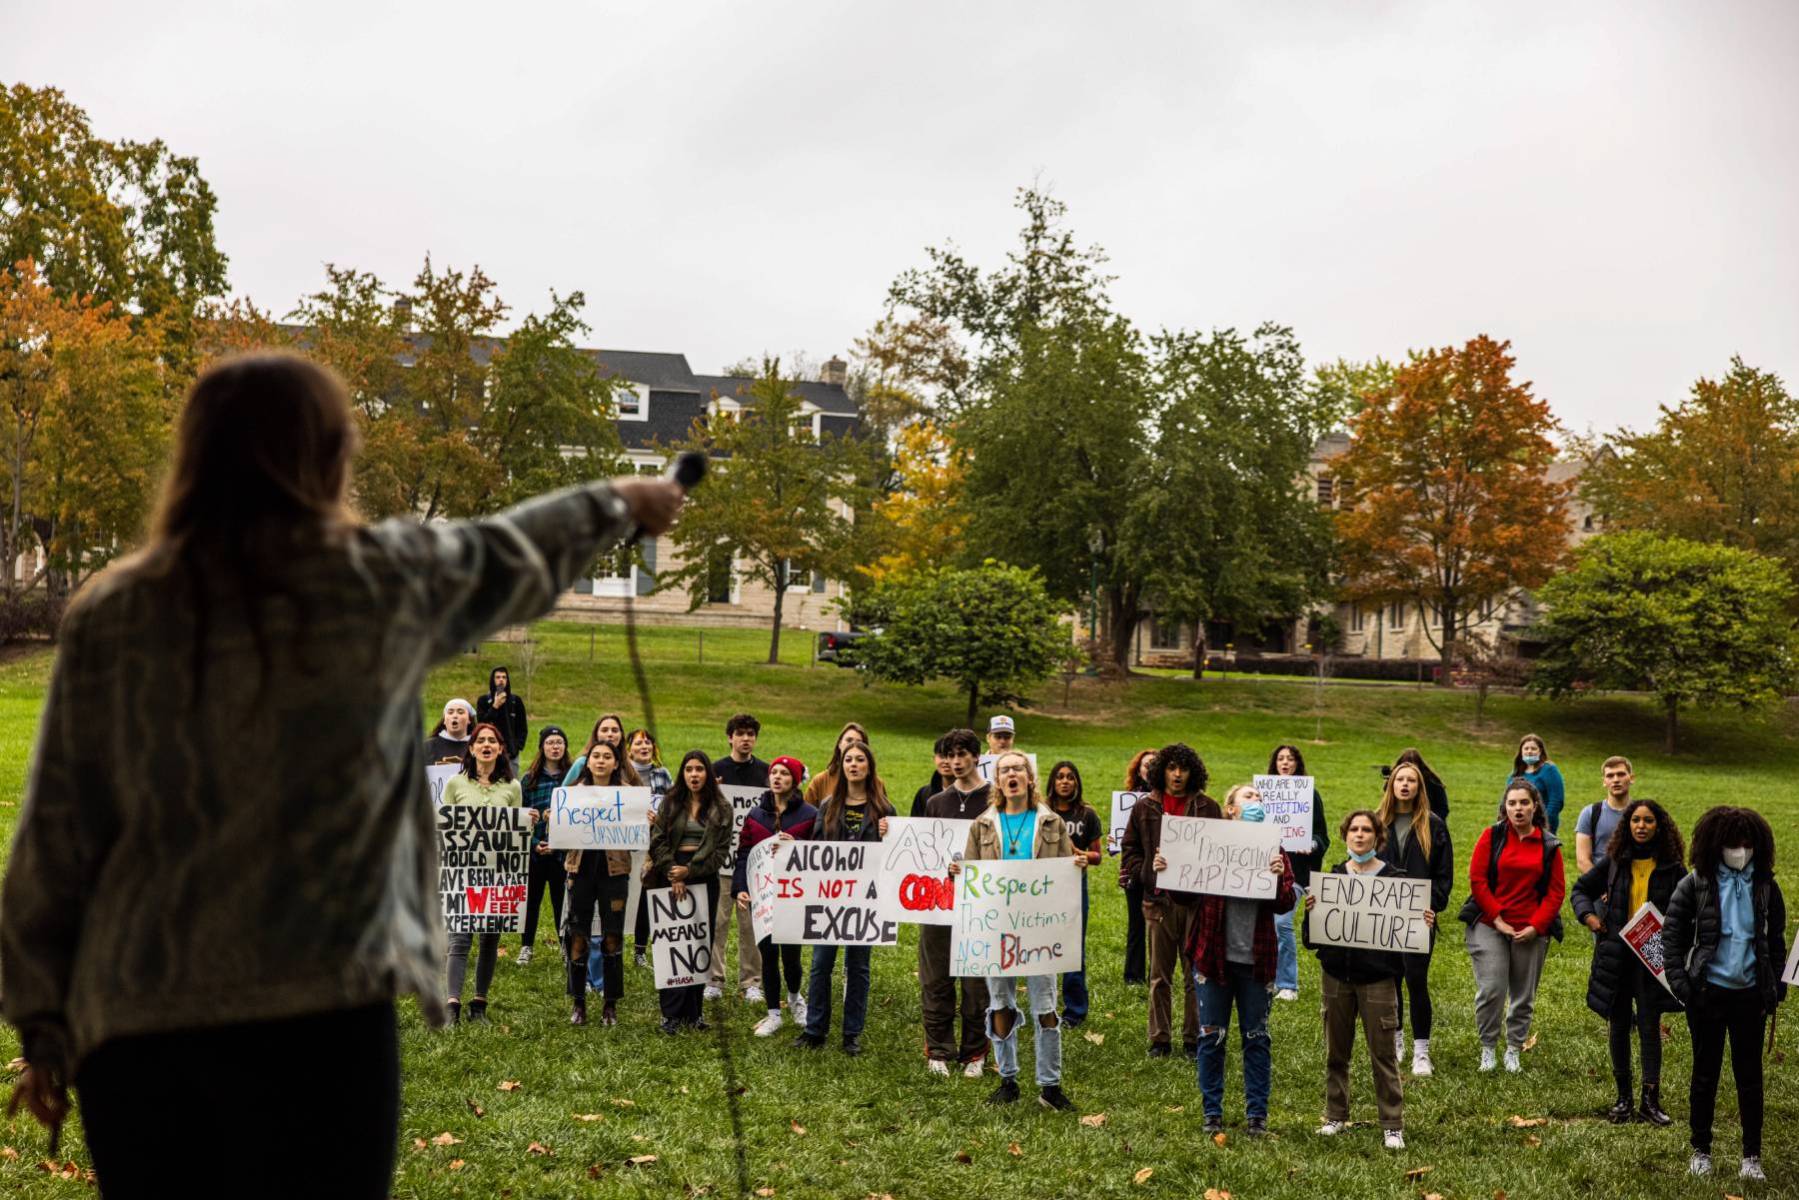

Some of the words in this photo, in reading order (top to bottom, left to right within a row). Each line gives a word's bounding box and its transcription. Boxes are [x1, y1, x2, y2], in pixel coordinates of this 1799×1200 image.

[1256, 779, 1273, 789] WHO
[1275, 779, 1289, 789] ARE
[1294, 779, 1308, 789] YOU
[1263, 791, 1300, 801] REALLY
[437, 805, 527, 831] SEXUAL
[557, 789, 625, 832] Respect
[1263, 802, 1310, 814] OTECTING
[1272, 814, 1290, 824] AND
[1164, 818, 1205, 844] STOP
[440, 852, 486, 867] HOULD
[496, 853, 529, 873] NOT
[440, 868, 465, 891] AVE
[467, 868, 495, 886] BEEN
[777, 878, 804, 898] IS
[818, 880, 857, 898] NOT
[866, 880, 877, 899] A
[963, 864, 1054, 906] Respect
[1179, 864, 1272, 893] RAPISTS
[446, 893, 466, 914] MY
[652, 889, 696, 923] NO
[1321, 877, 1365, 906] END
[1370, 879, 1426, 911] RAPE
[444, 915, 519, 932] XPERIENCE
[803, 905, 896, 942] EXCUSE
[960, 903, 998, 934] The
[1008, 911, 1068, 930] Victims
[1325, 908, 1422, 950] CULTURE
[652, 922, 706, 944] MEANS
[670, 944, 711, 976] NO
[1001, 932, 1063, 970] Blame
